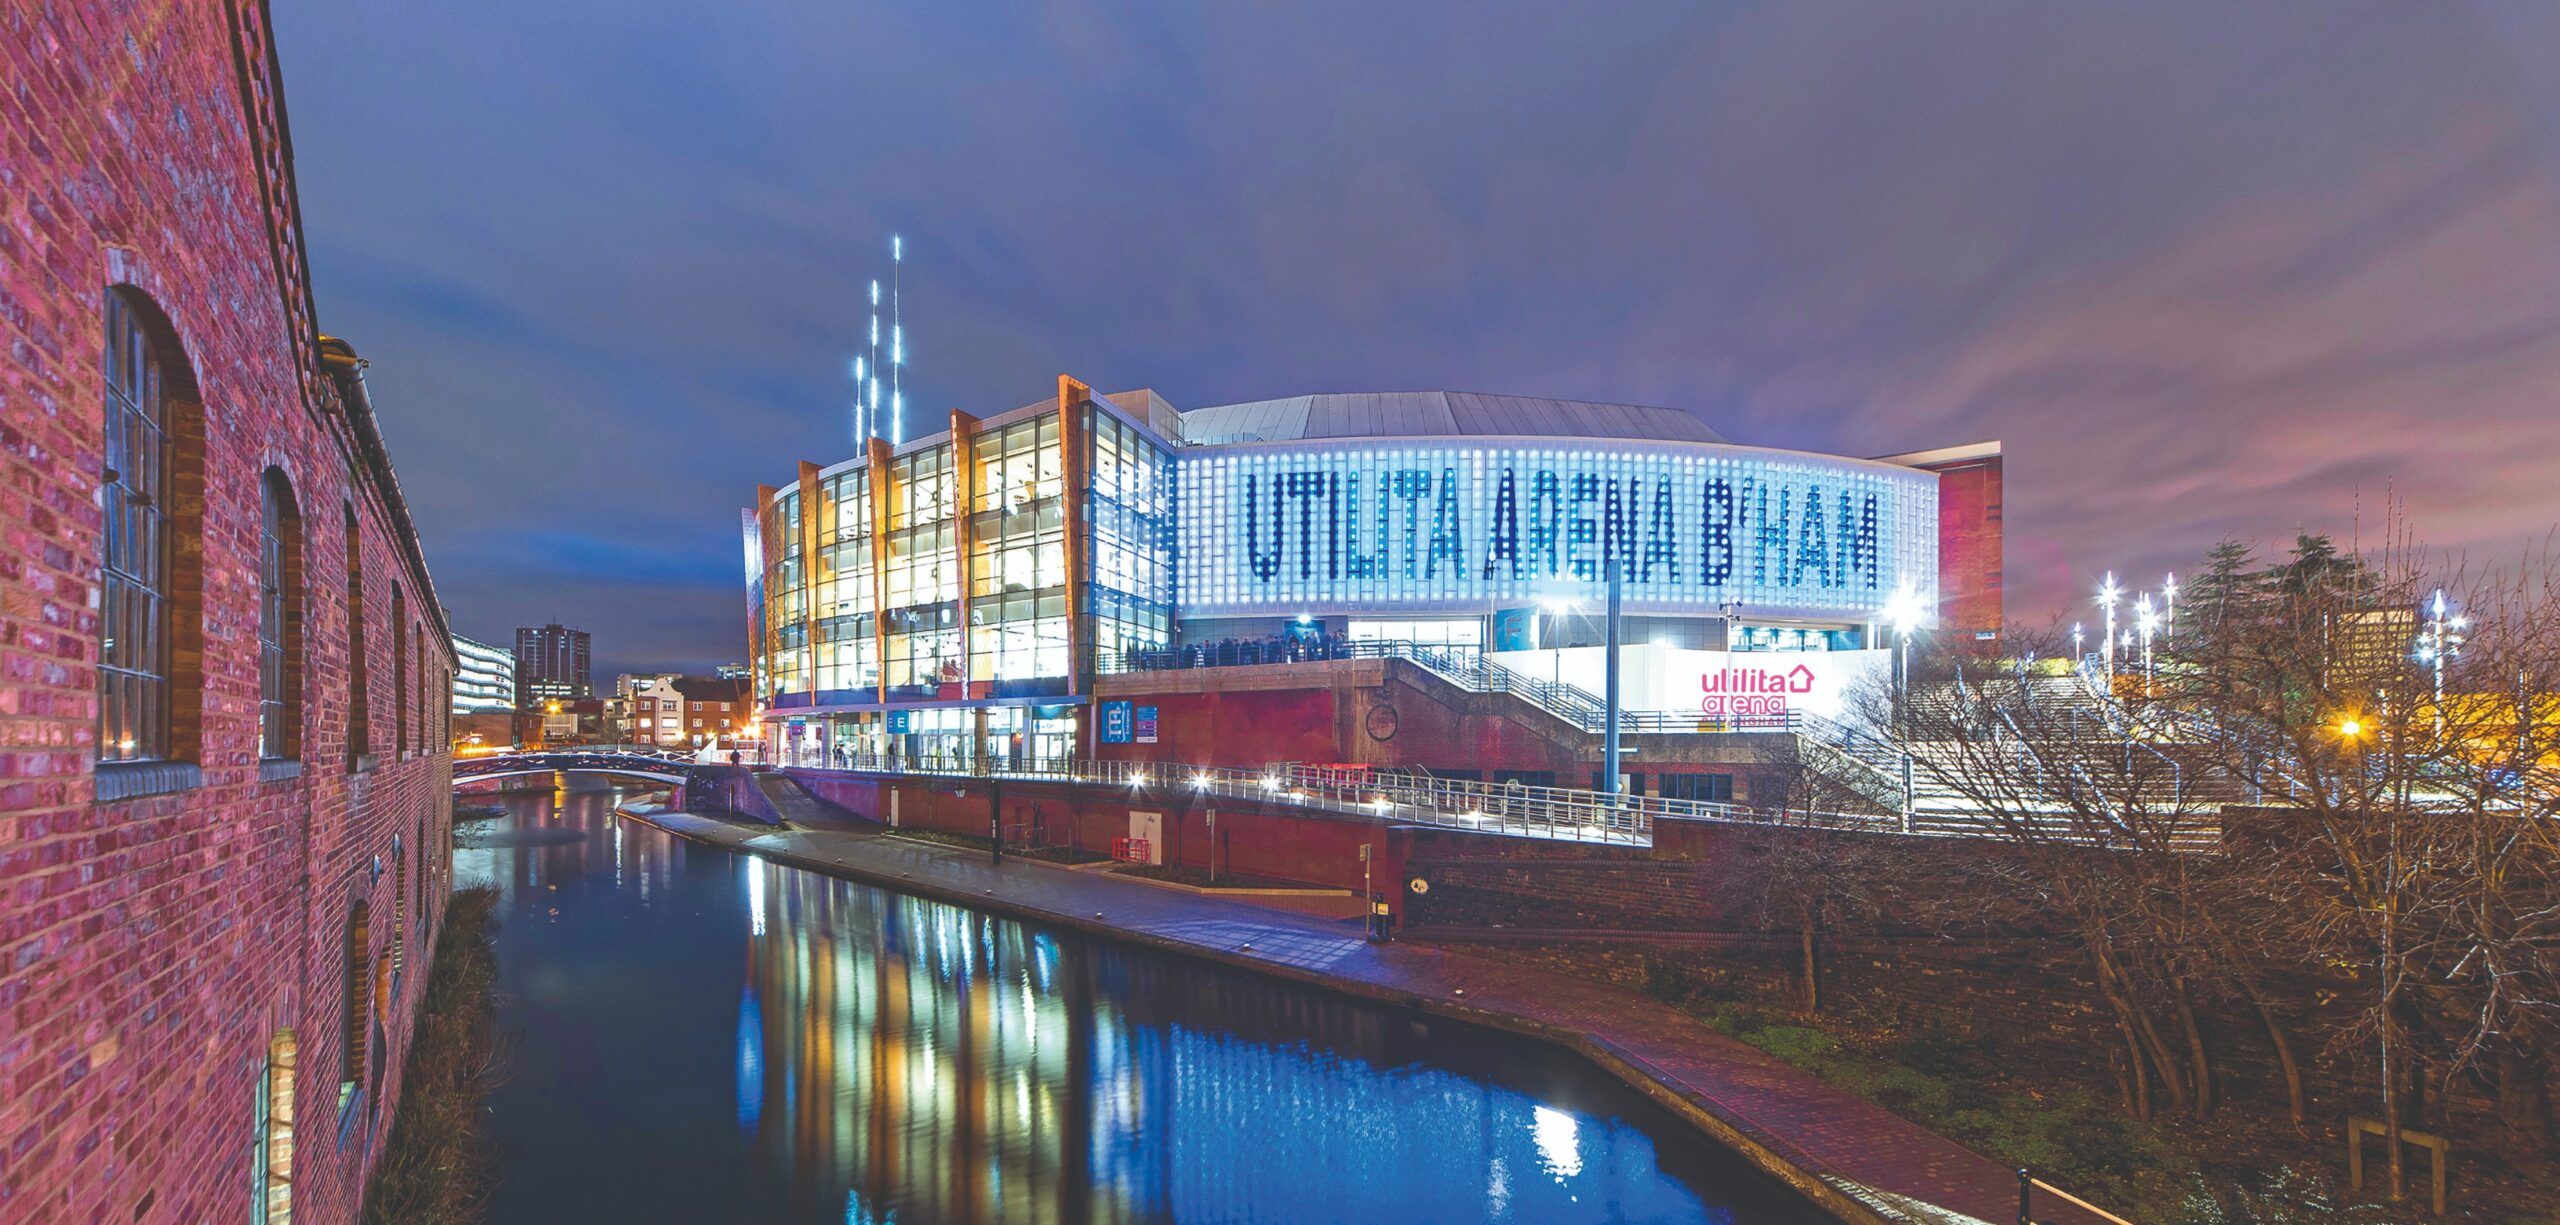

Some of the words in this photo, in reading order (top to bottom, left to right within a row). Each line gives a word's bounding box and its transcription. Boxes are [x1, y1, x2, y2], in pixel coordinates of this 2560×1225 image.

[1247, 468, 1466, 582] UTILITA
[1483, 467, 1681, 584] ARENA
[1701, 475, 1877, 590] B'HAM
[897, 717, 905, 728] E
[1702, 717, 1786, 727] INGHAM
